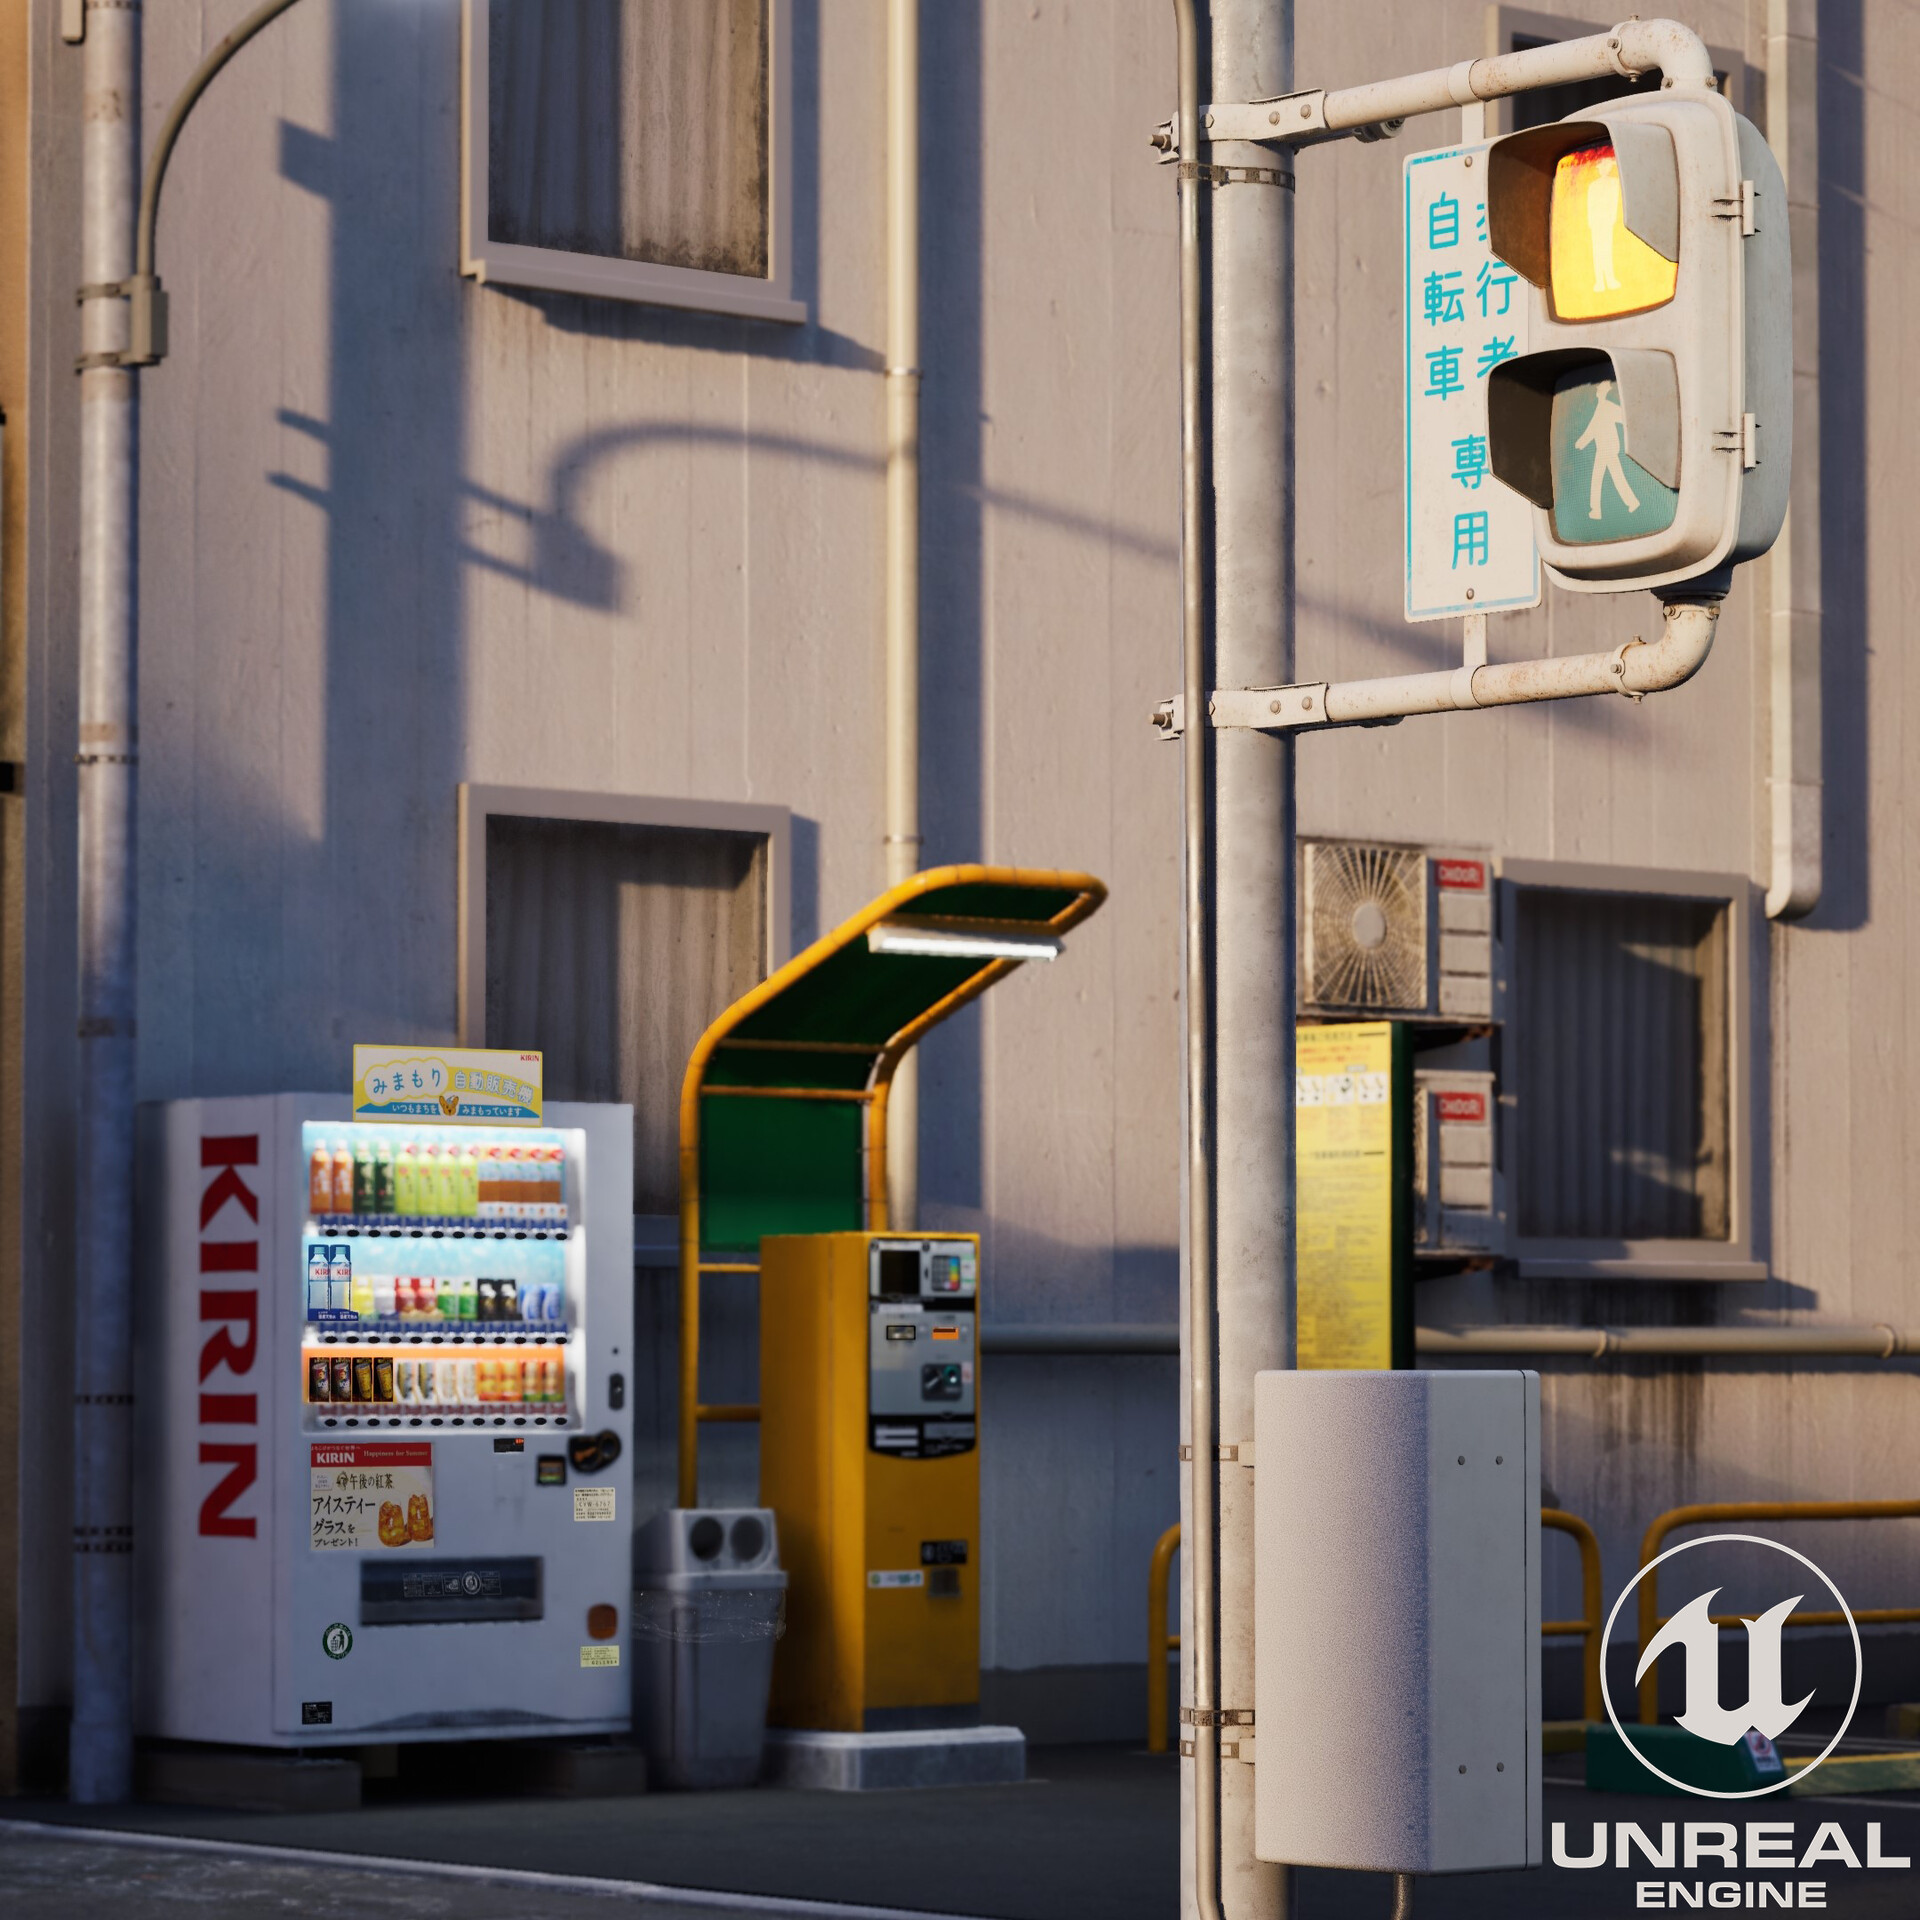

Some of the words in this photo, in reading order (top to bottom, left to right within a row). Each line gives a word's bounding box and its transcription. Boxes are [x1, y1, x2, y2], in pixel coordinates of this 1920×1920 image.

[1424, 191, 1464, 400] 自転車
[1451, 434, 1489, 569] 専用
[521, 1054, 539, 1062] KIRIN
[373, 1068, 440, 1094] みまもり
[455, 1070, 533, 1105] 自動販売機
[392, 1104, 438, 1114] いつもまちを
[462, 1106, 522, 1116] みまもっています
[198, 1134, 258, 1539] KIRIN
[316, 1452, 355, 1463] KIRIN
[349, 1473, 394, 1490] 午後の紅茶
[312, 1495, 376, 1515] アイスティー
[312, 1518, 356, 1535] グラスを
